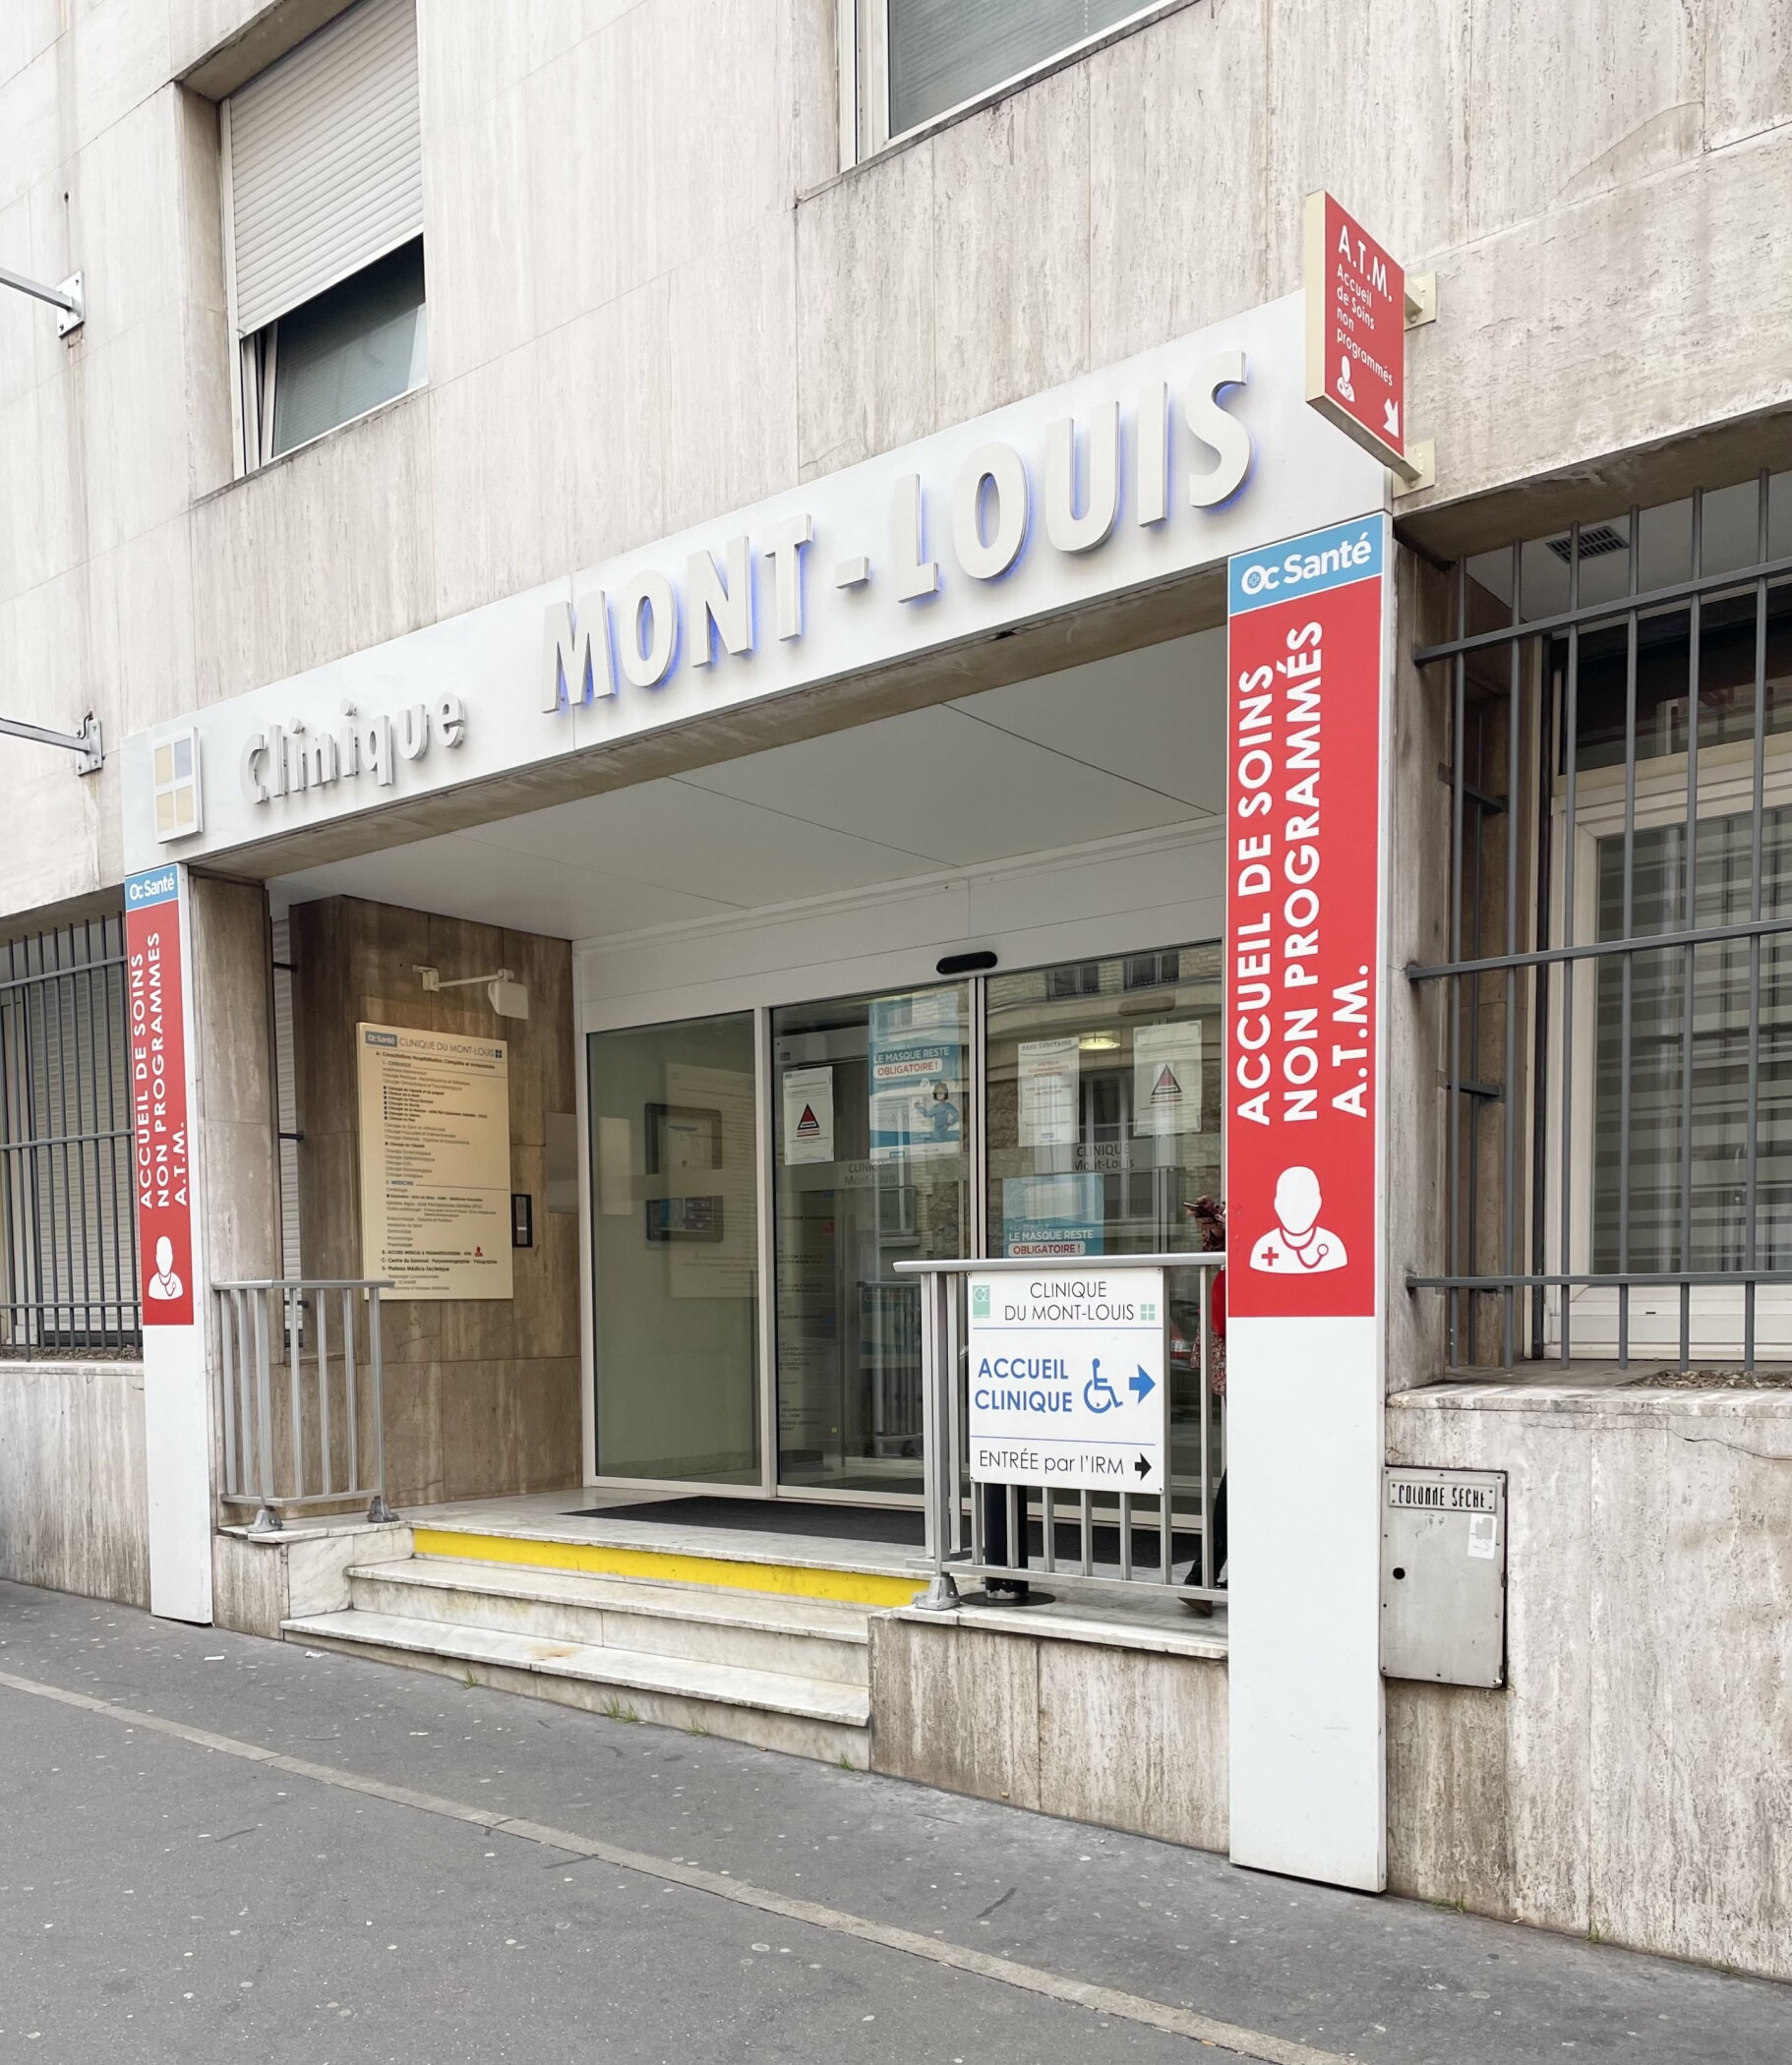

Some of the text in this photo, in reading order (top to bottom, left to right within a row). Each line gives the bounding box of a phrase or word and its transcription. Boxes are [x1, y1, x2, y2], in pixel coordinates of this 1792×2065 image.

[1338, 224, 1393, 302] A.T.M.
[1337, 264, 1372, 308] Accueil
[1337, 284, 1375, 330] de Soins
[1337, 306, 1354, 332] non
[1337, 327, 1394, 386] programmés
[1284, 531, 1372, 584] Santé
[239, 691, 465, 804] Clinique
[144, 872, 175, 897] Santé
[1276, 620, 1323, 1122] NON PROGRAMMÉS
[1236, 664, 1274, 1126] ACCUEIL DE SOINS
[399, 1037, 495, 1058] CLINIQUE DU MONT-LOUIS
[873, 1053, 884, 1064] LE
[885, 1049, 922, 1063] MASQUE
[923, 1046, 950, 1058] RESTE
[1332, 964, 1369, 1118] A.T.M.
[131, 953, 152, 1210] ACCUEIL DE SOINS
[148, 932, 169, 1208] NON PROGRAMMES
[877, 1062, 933, 1077] OBLIGATOIRE
[172, 1122, 187, 1207] A.T.M.
[1008, 1229, 1094, 1242] LE MASQUE RESTE
[1013, 1243, 1076, 1255] OBLIGATOIRE
[1030, 1281, 1106, 1299] CLINIQUE
[1004, 1303, 1135, 1321] DU MONT-LOUIS
[978, 1358, 1069, 1380] ACCUEIL
[975, 1388, 1072, 1413] CLINIQUE
[980, 1447, 1124, 1475] ENTRÉE par l'IRM
